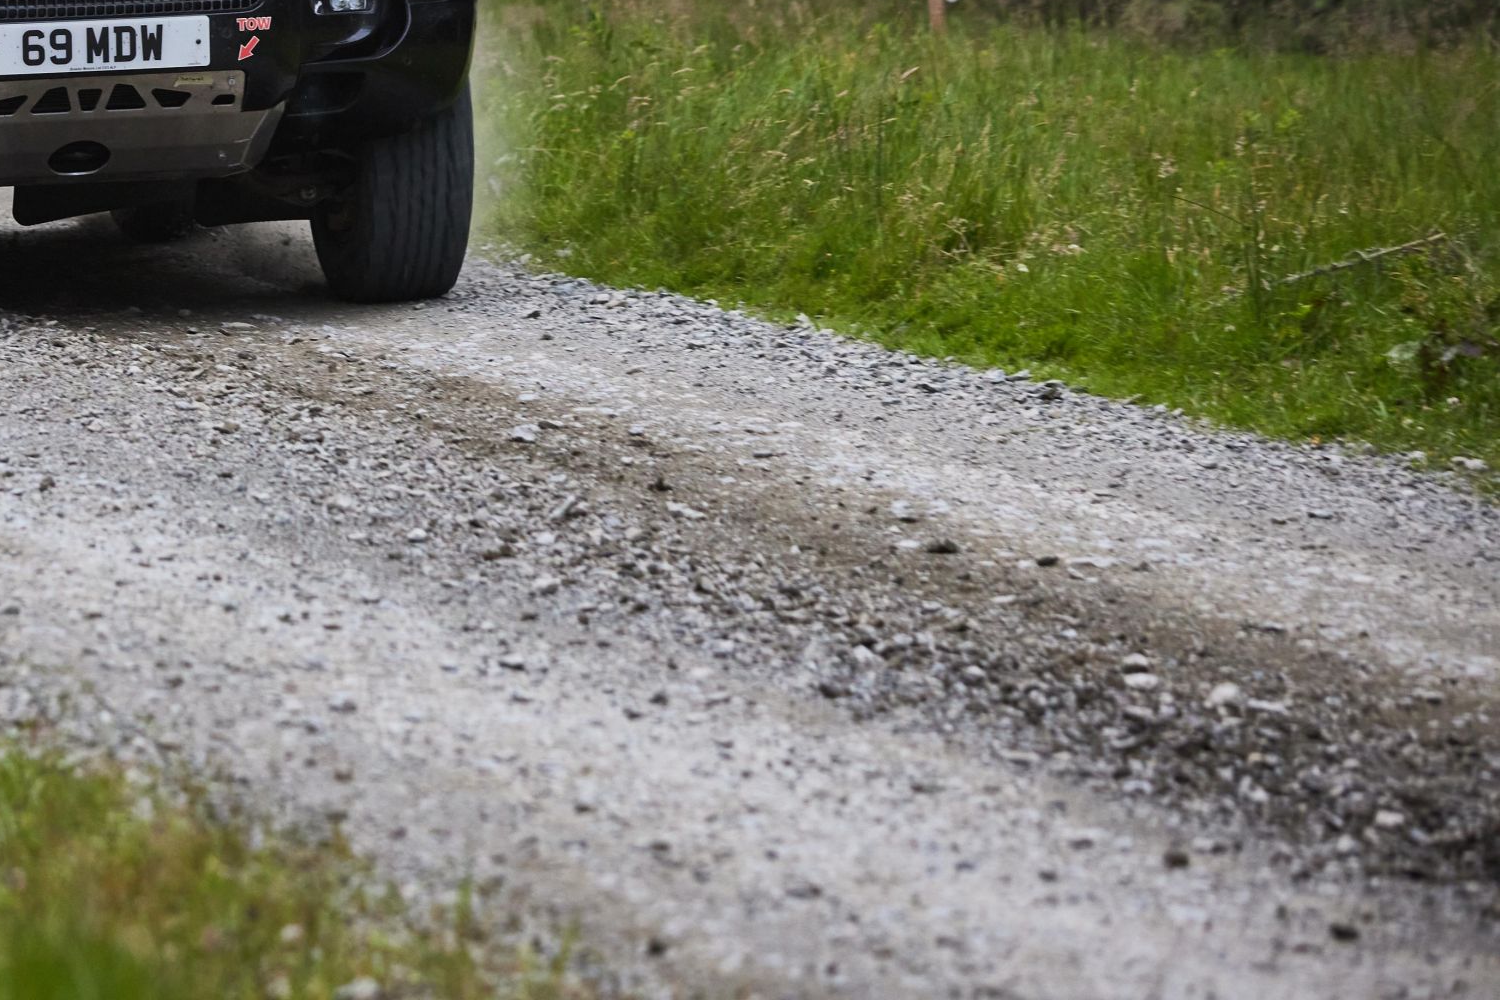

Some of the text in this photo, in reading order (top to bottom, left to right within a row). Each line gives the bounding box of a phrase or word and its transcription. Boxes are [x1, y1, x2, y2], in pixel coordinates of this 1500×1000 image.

[236, 16, 272, 32] TOW
[22, 24, 163, 67] 69 MDW
